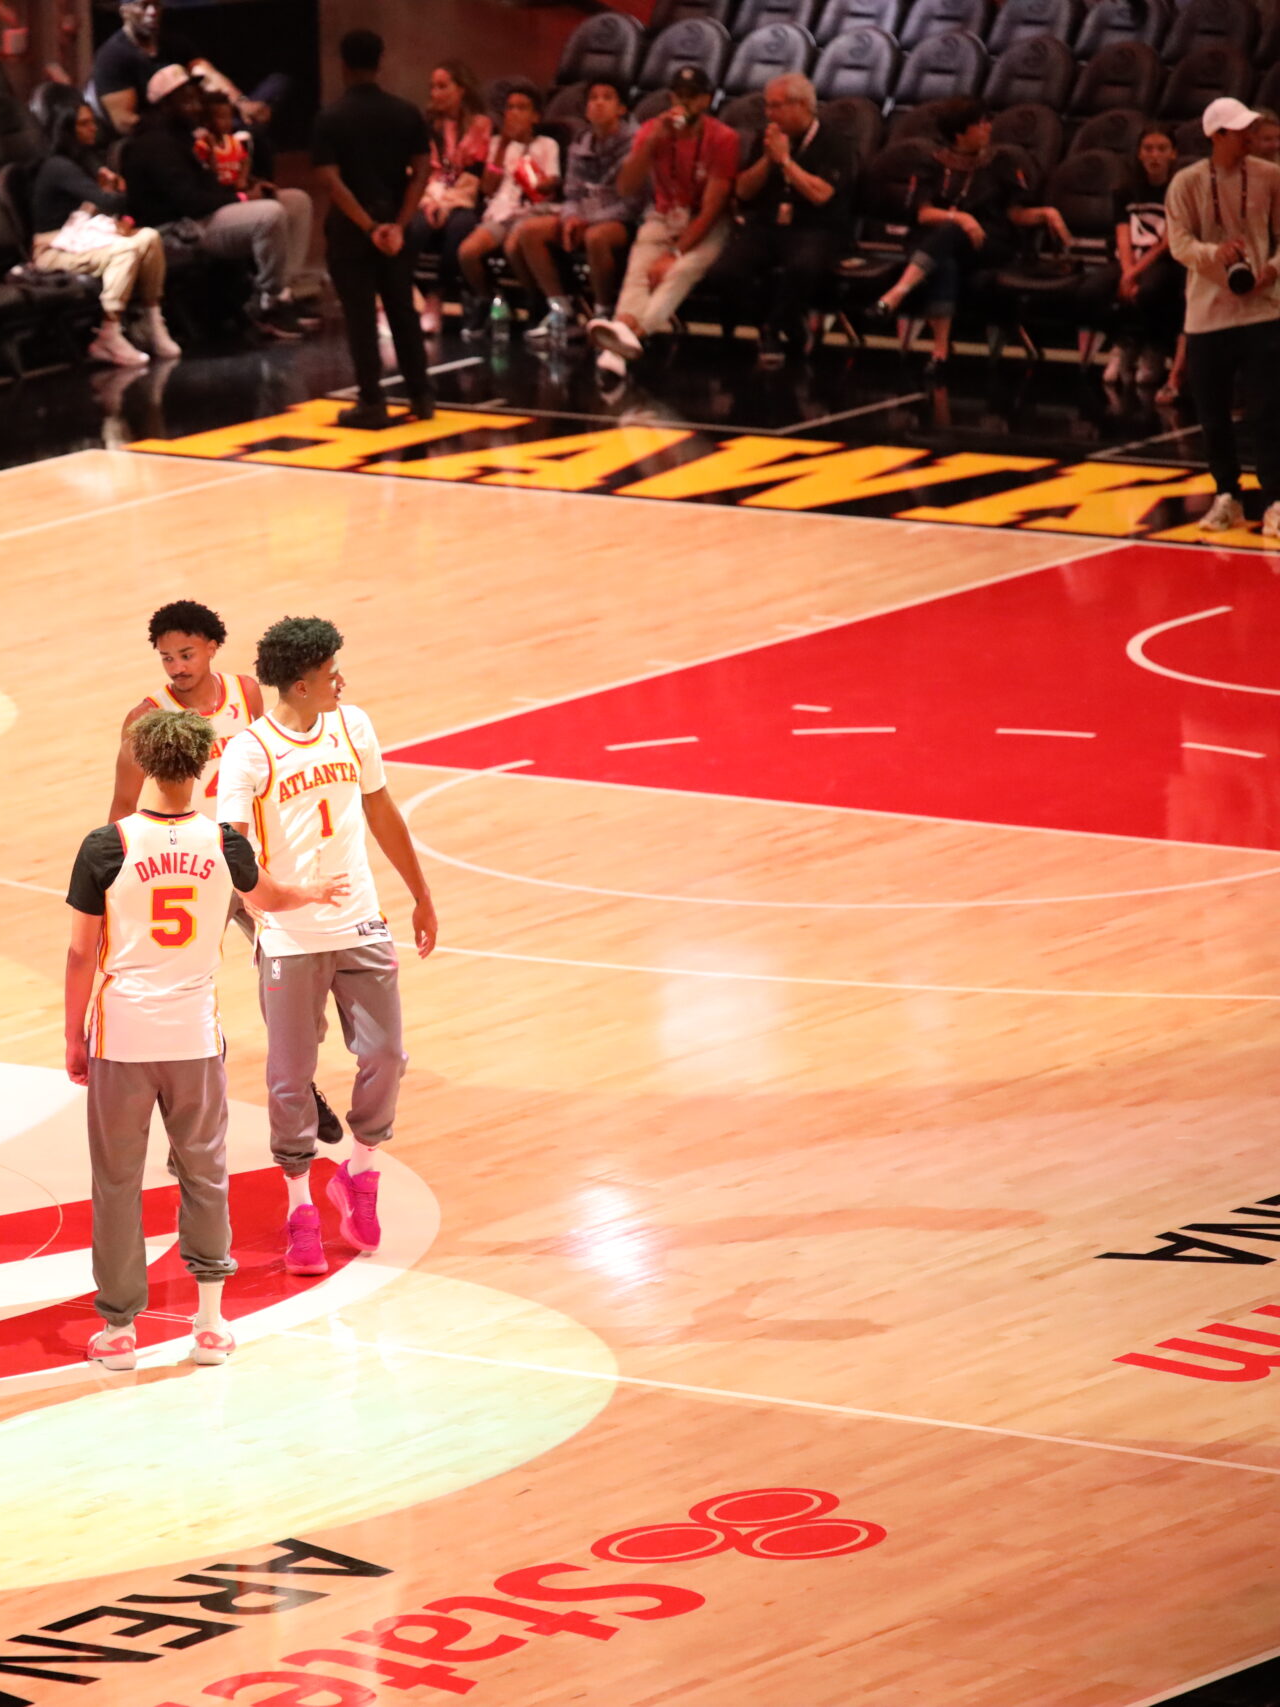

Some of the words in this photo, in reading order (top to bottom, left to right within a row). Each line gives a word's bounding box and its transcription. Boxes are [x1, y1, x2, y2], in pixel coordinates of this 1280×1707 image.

[278, 762, 358, 803] ATLANTA
[317, 798, 336, 838] 1
[134, 851, 215, 883] DANIELS
[150, 885, 198, 949] 5
